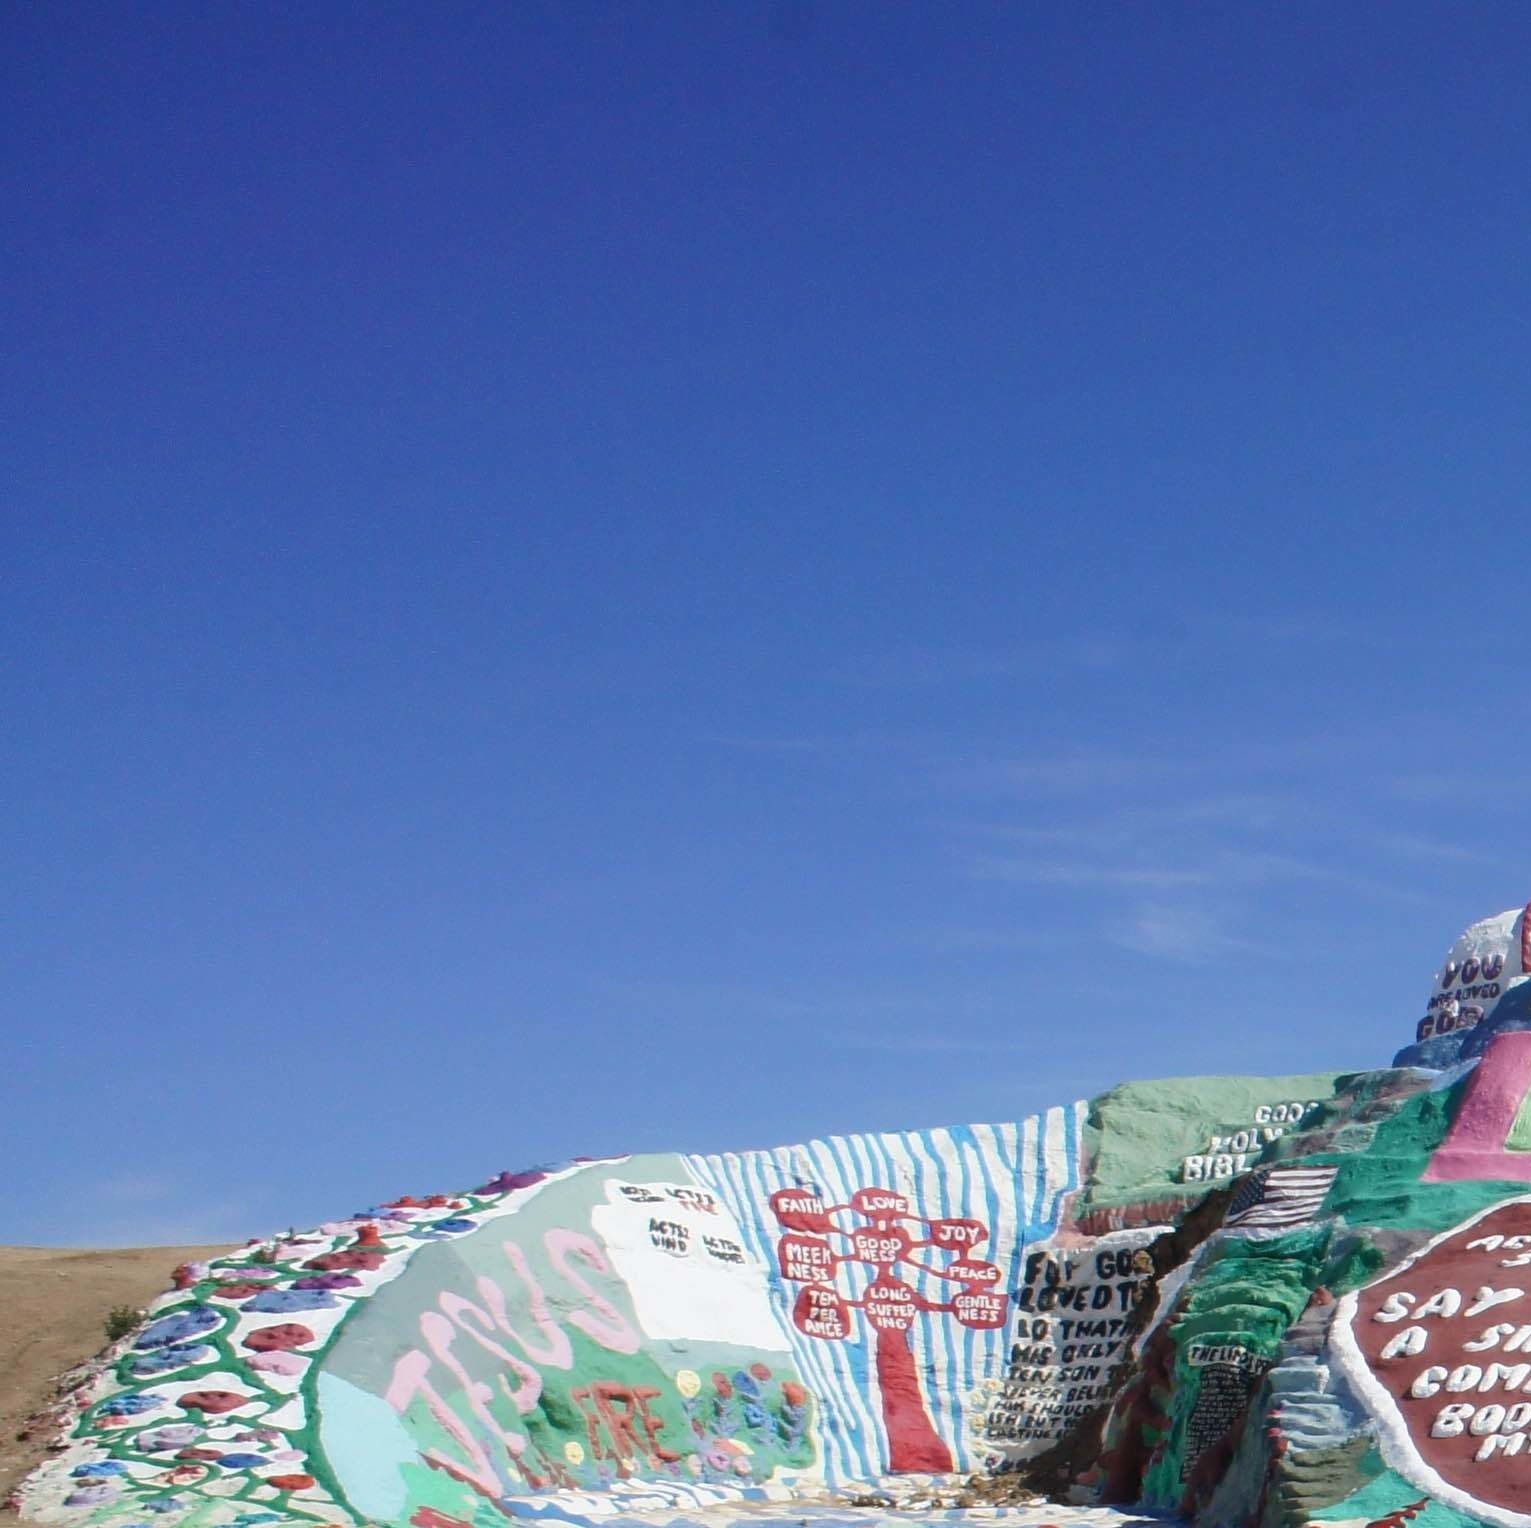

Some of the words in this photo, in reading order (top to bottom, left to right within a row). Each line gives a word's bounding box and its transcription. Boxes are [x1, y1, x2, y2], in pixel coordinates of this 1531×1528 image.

[1184, 1154, 1252, 1183] BIBL
[778, 1198, 824, 1215] FAITH
[862, 1195, 907, 1213] LOVE
[938, 1225, 980, 1242] JOY
[855, 1235, 902, 1251] GOOD
[859, 1249, 897, 1263] NESS
[787, 1262, 829, 1281] NESS
[950, 1266, 998, 1281] PEACE
[808, 1290, 840, 1307] TEM
[870, 1287, 912, 1302] LONG
[955, 1295, 1003, 1311] GENTLE
[1018, 1285, 1113, 1313] LOVED
[867, 1303, 917, 1318] SUFFER
[1373, 1286, 1525, 1322] SAY
[809, 1306, 840, 1323] PER
[876, 1316, 908, 1330] ING
[957, 1308, 1000, 1322] NESS
[804, 1319, 845, 1338] ANCE
[1380, 1325, 1428, 1359] A
[1058, 1365, 1101, 1382] SON
